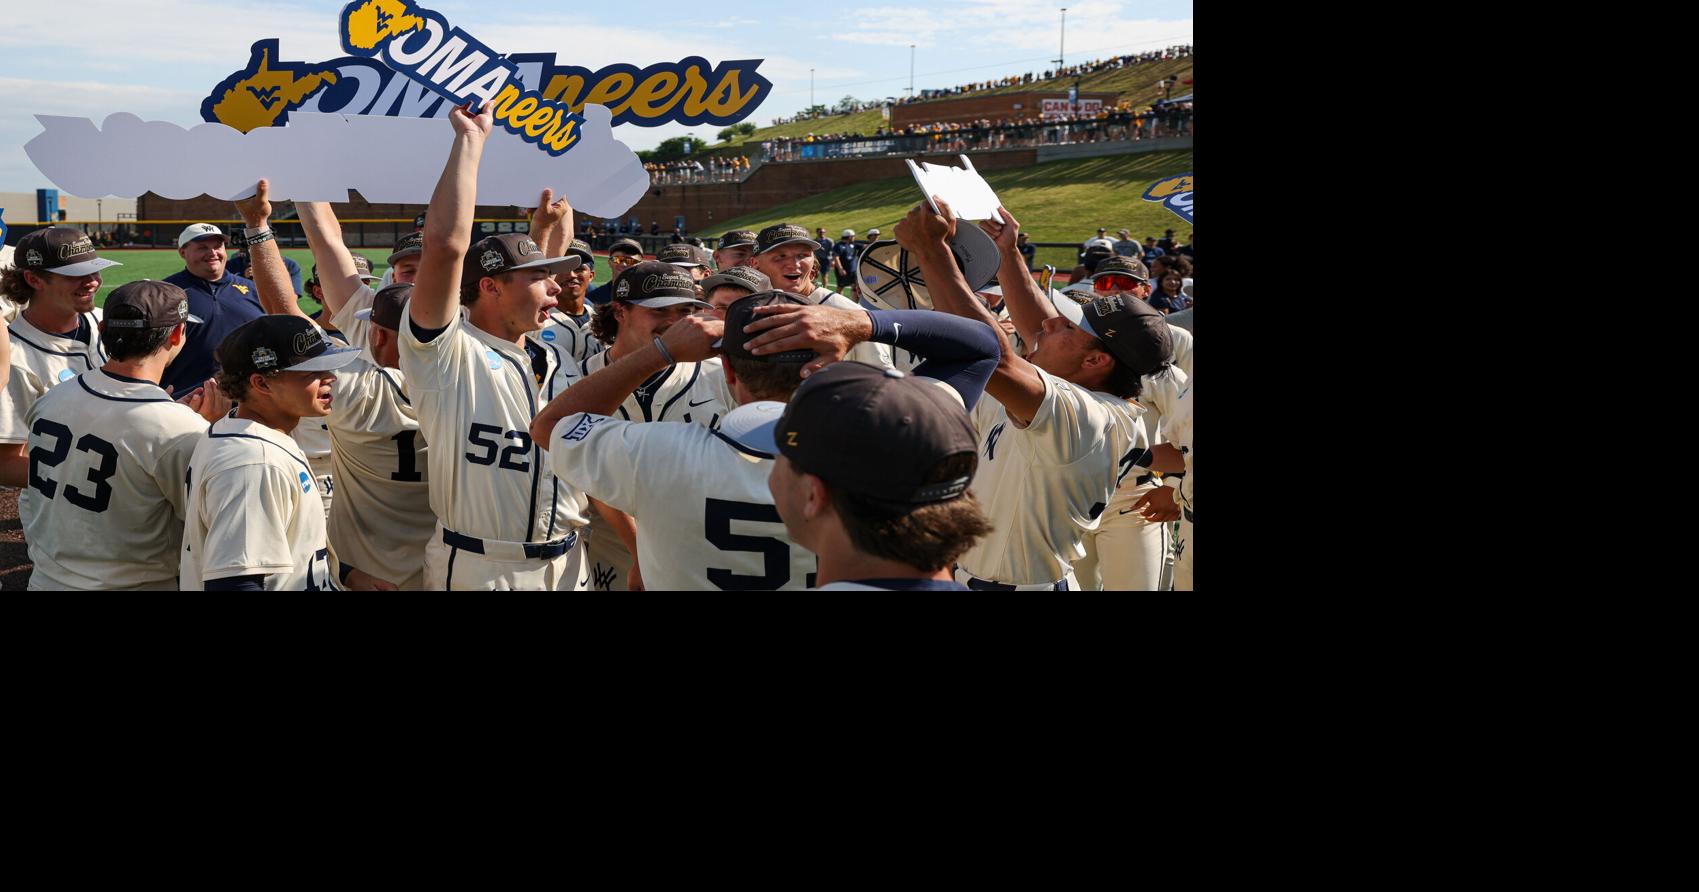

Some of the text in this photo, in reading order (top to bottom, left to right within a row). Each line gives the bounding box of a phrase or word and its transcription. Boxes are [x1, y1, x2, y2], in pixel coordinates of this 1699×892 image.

[1044, 102, 1069, 112] CAN
[29, 418, 119, 513] 23
[465, 422, 533, 472] 52
[705, 498, 818, 591] 5
